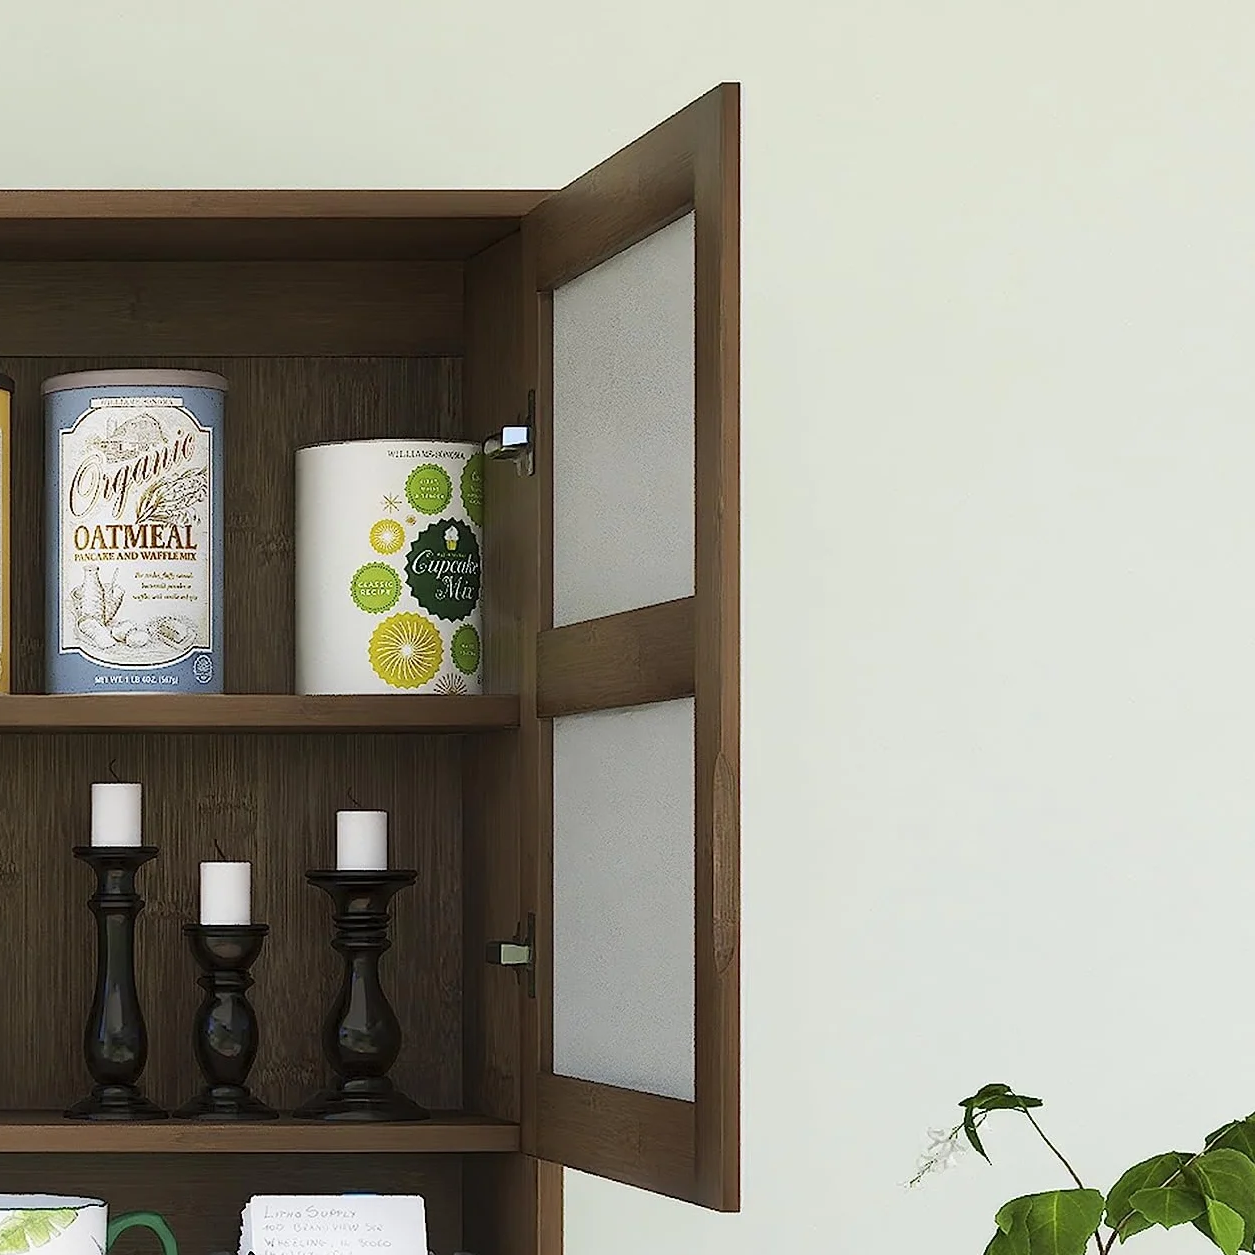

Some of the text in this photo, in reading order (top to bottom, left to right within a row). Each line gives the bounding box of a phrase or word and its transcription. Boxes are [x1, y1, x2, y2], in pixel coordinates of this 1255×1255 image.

[69, 430, 194, 518] Organic
[74, 524, 198, 550] OATMEAL
[117, 552, 138, 560] AND
[140, 552, 178, 561] WAFFLE
[178, 552, 197, 561] MIX
[412, 550, 479, 579] Cupcake
[435, 576, 475, 600] Mix
